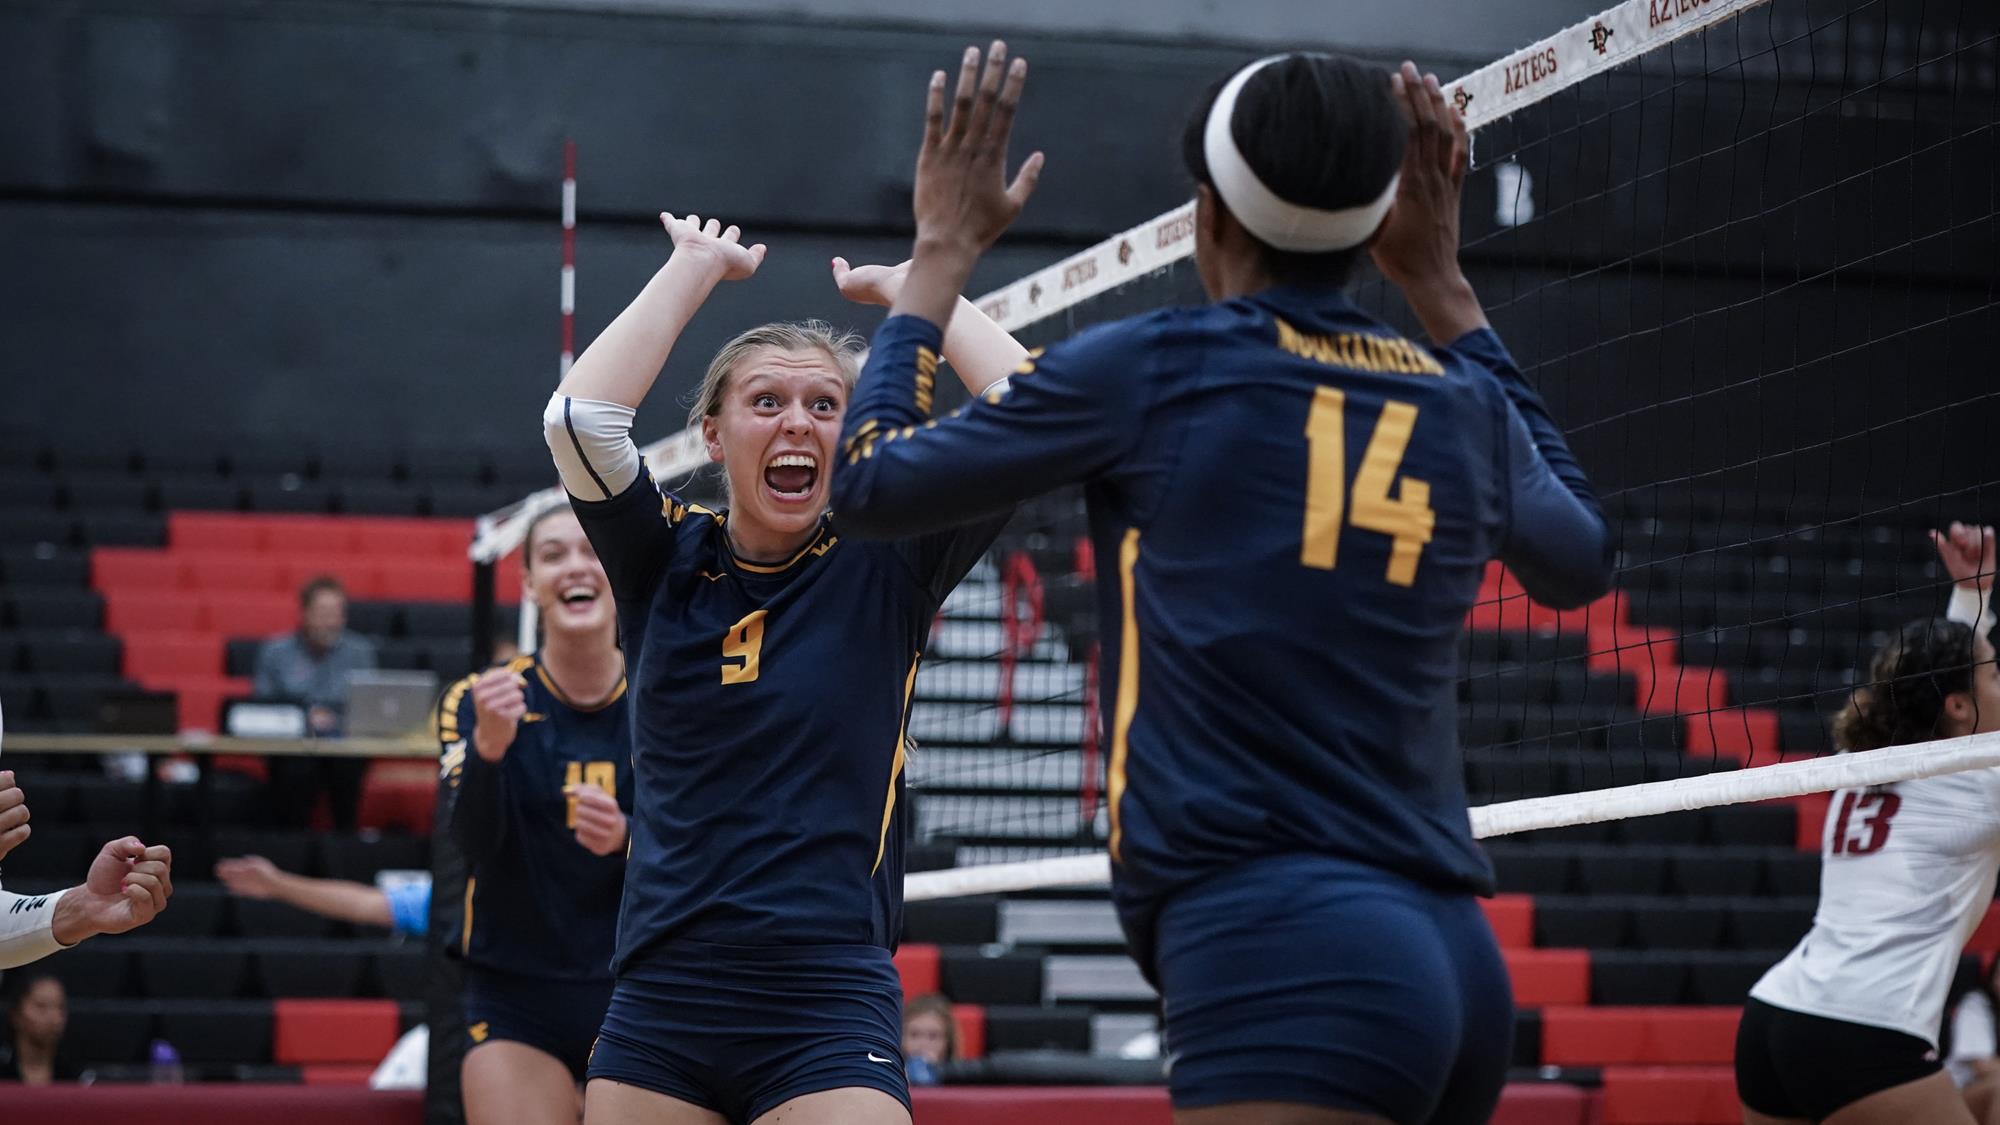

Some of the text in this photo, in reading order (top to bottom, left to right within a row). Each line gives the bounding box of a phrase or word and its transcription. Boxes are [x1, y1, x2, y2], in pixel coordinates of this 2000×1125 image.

[1504, 47, 1558, 94] AZTECS
[1300, 385, 1435, 587] 14
[720, 609, 769, 685] 9
[1832, 792, 1903, 854] 13
